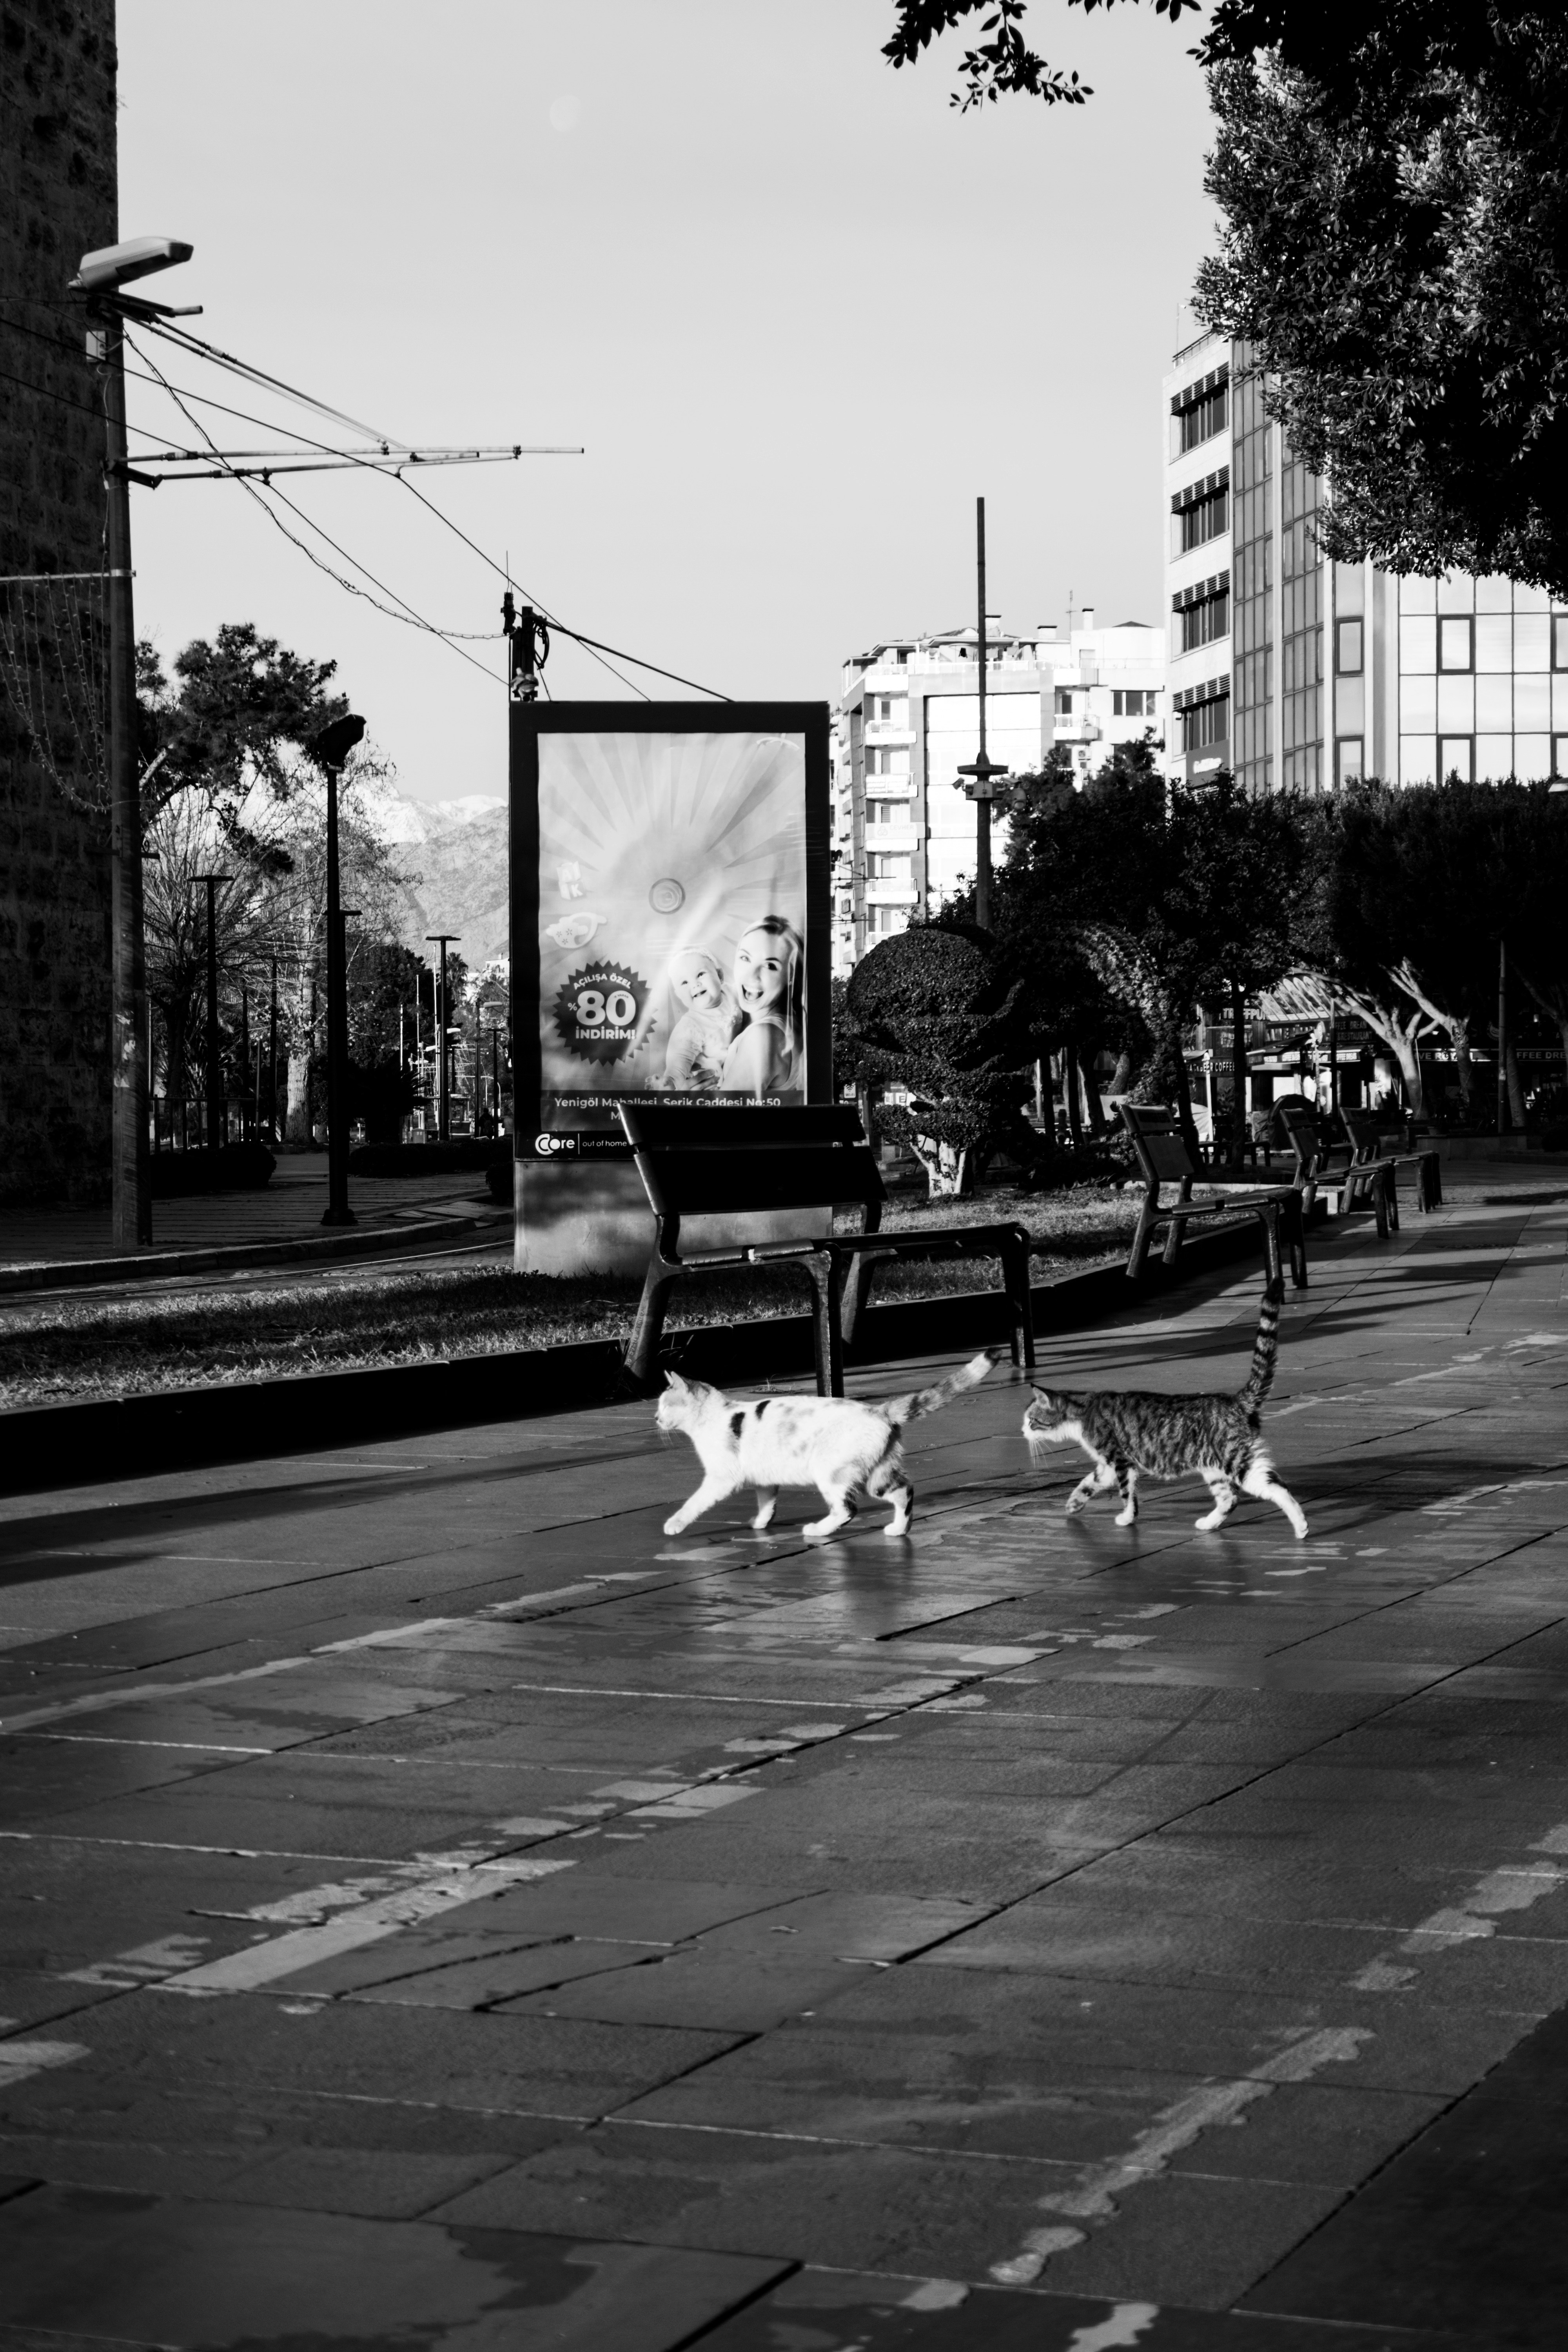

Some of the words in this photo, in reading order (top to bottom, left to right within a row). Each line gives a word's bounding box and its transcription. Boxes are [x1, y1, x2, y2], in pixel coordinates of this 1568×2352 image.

[573, 973, 607, 989] AÇILIŞA
[610, 973, 631, 989] ÖZEL
[576, 1026, 635, 1039] İNDİRİM!
[555, 1097, 598, 1109] Yenigöl
[696, 1098, 743, 1106] Caddesi
